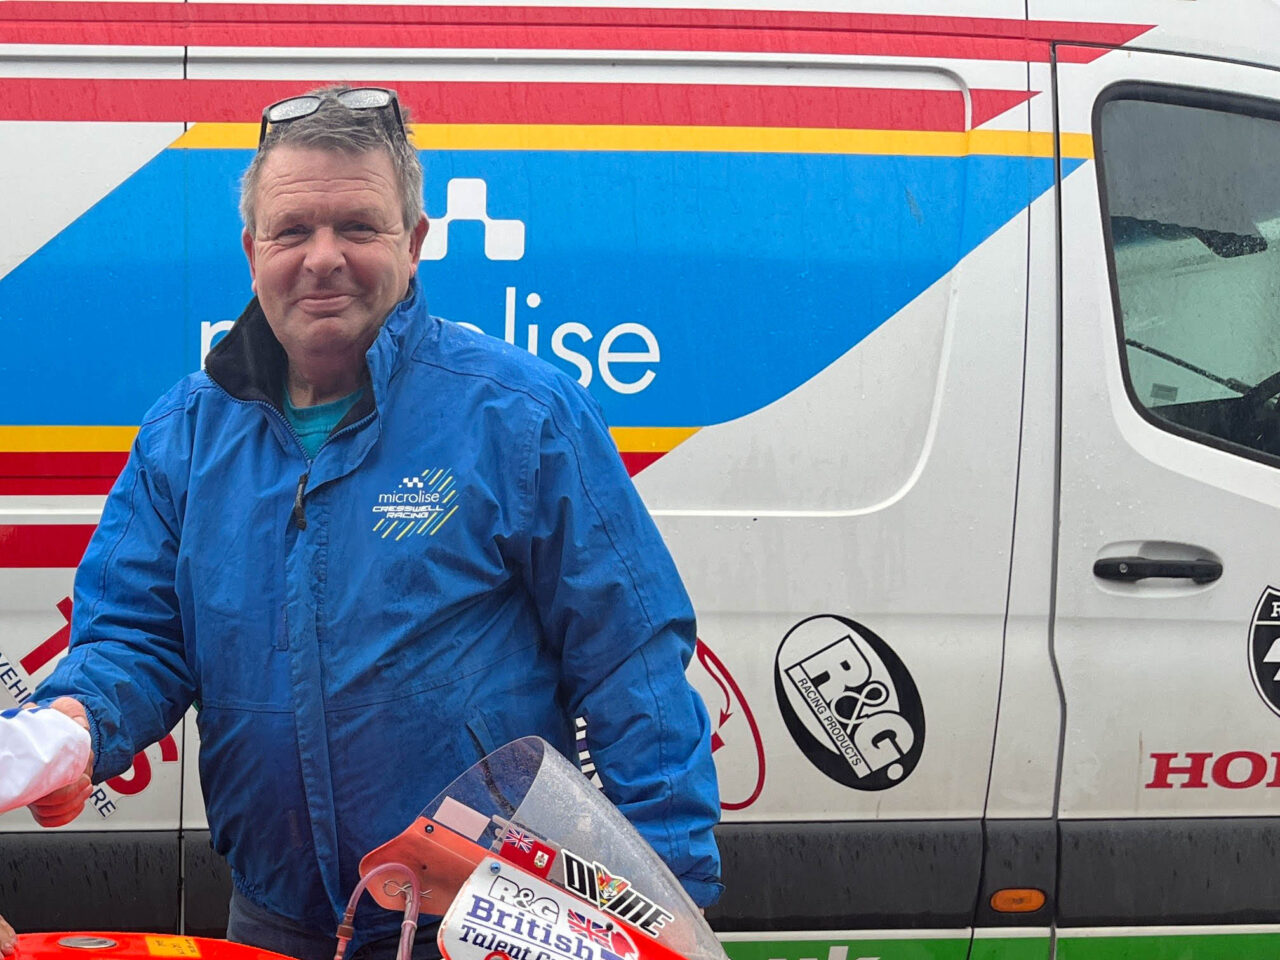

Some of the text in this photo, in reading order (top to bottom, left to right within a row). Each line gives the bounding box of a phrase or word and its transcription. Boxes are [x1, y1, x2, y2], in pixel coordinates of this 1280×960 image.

[378, 490, 440, 503] microlise
[386, 511, 429, 519] RACING
[797, 677, 863, 767] RACING PRODUCTS
[800, 634, 916, 773] R&G
[1145, 751, 1280, 790] HO
[488, 875, 560, 925] R&G
